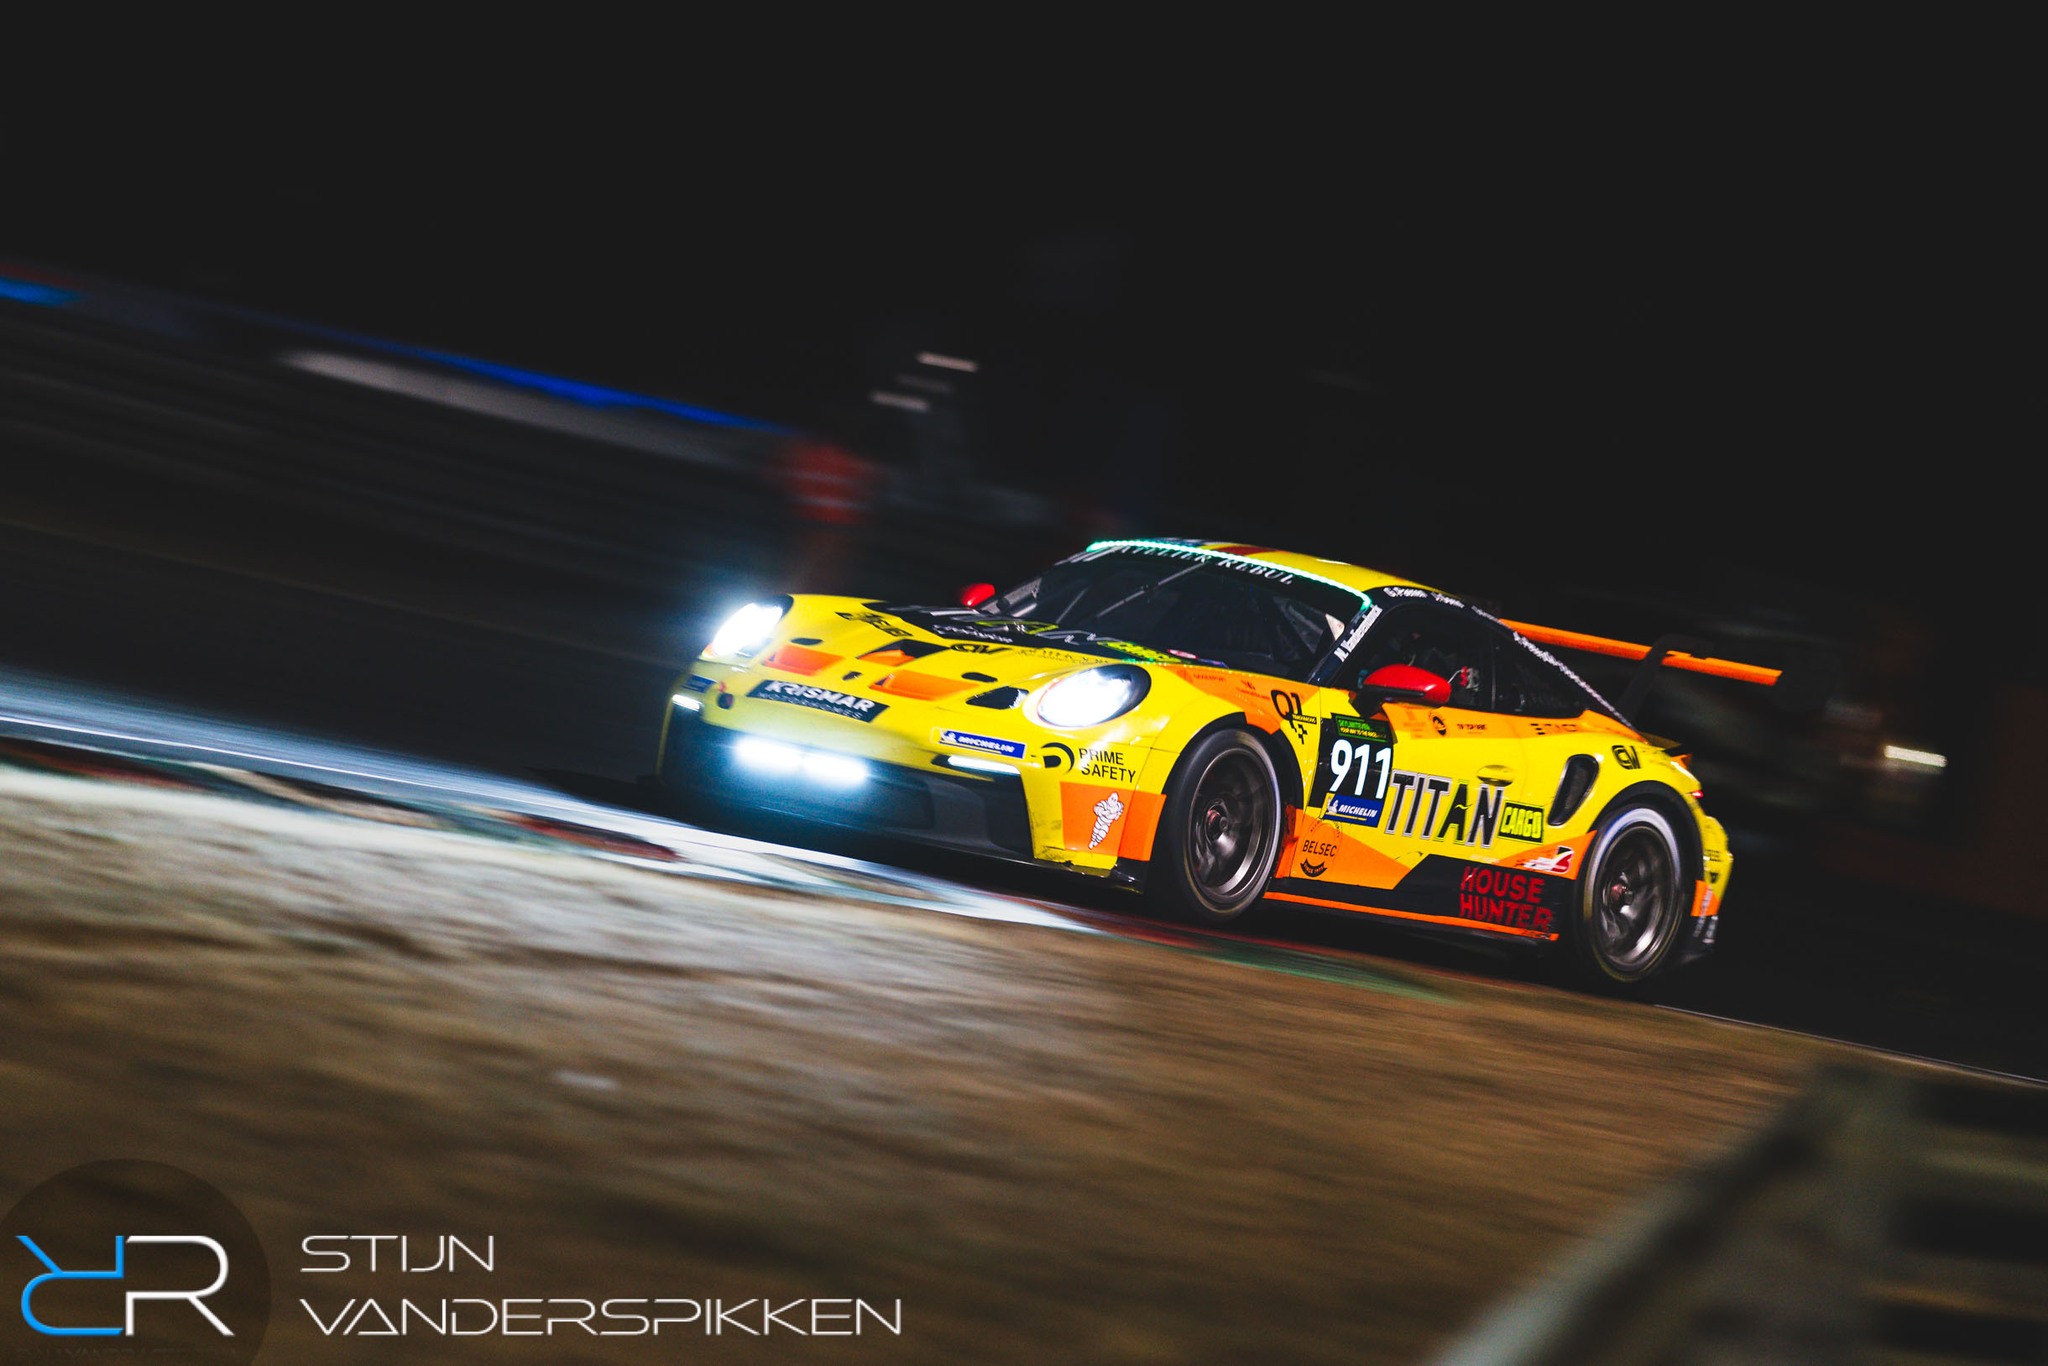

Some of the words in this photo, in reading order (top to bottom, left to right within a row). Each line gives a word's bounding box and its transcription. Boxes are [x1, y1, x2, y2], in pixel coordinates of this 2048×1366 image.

[765, 680, 875, 712] KRISMAR
[958, 736, 1015, 752] MICHELIN
[1079, 748, 1124, 765] PRIME
[1081, 763, 1136, 783] SAFETY
[1329, 739, 1391, 799] 911
[1338, 804, 1378, 818] MICHELIN
[1385, 769, 1504, 848] TITAN
[1500, 806, 1542, 839] CARGO
[1302, 840, 1337, 857] BELSEC
[1460, 865, 1545, 903] HOUSE
[1459, 893, 1553, 933] HUNTER
